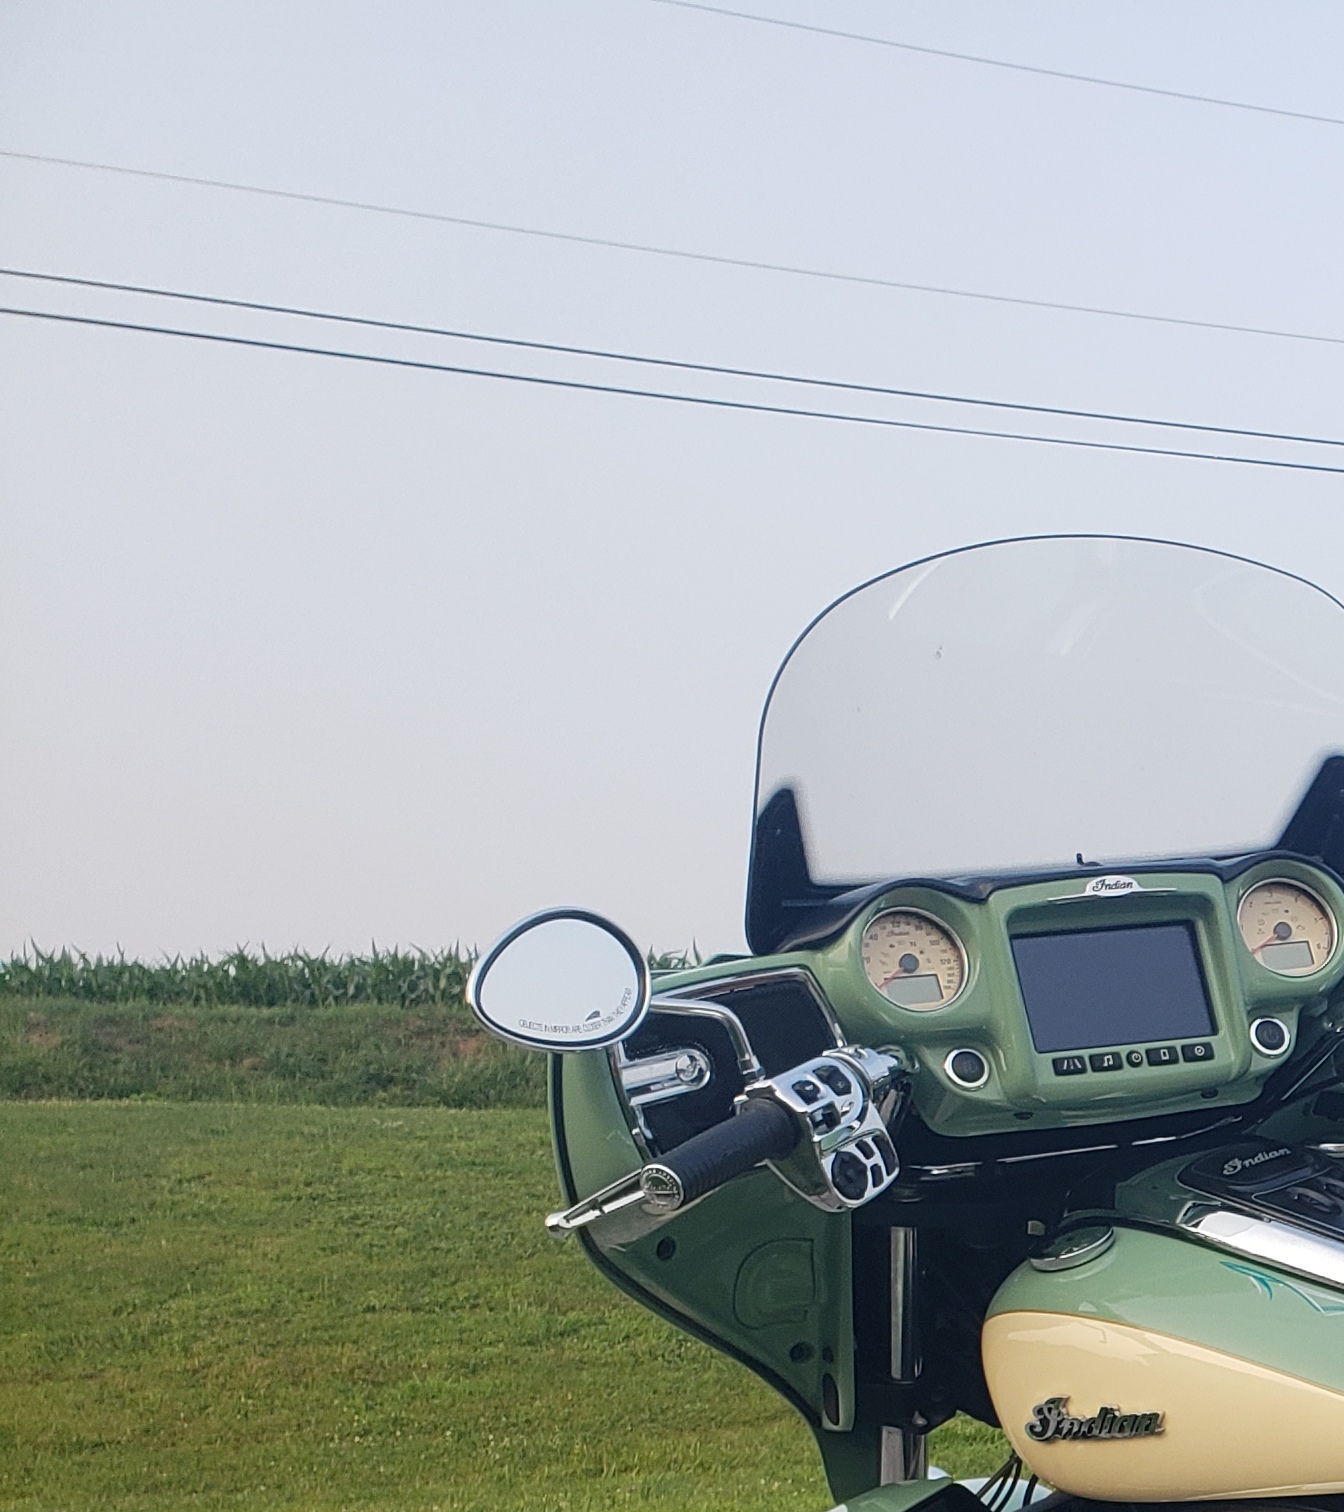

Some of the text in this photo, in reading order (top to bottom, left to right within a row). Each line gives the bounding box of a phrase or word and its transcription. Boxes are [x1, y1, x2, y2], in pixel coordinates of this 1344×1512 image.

[1092, 879, 1134, 892] Indian
[1222, 1148, 1292, 1176] Indian
[1025, 1394, 1165, 1442] Indian
